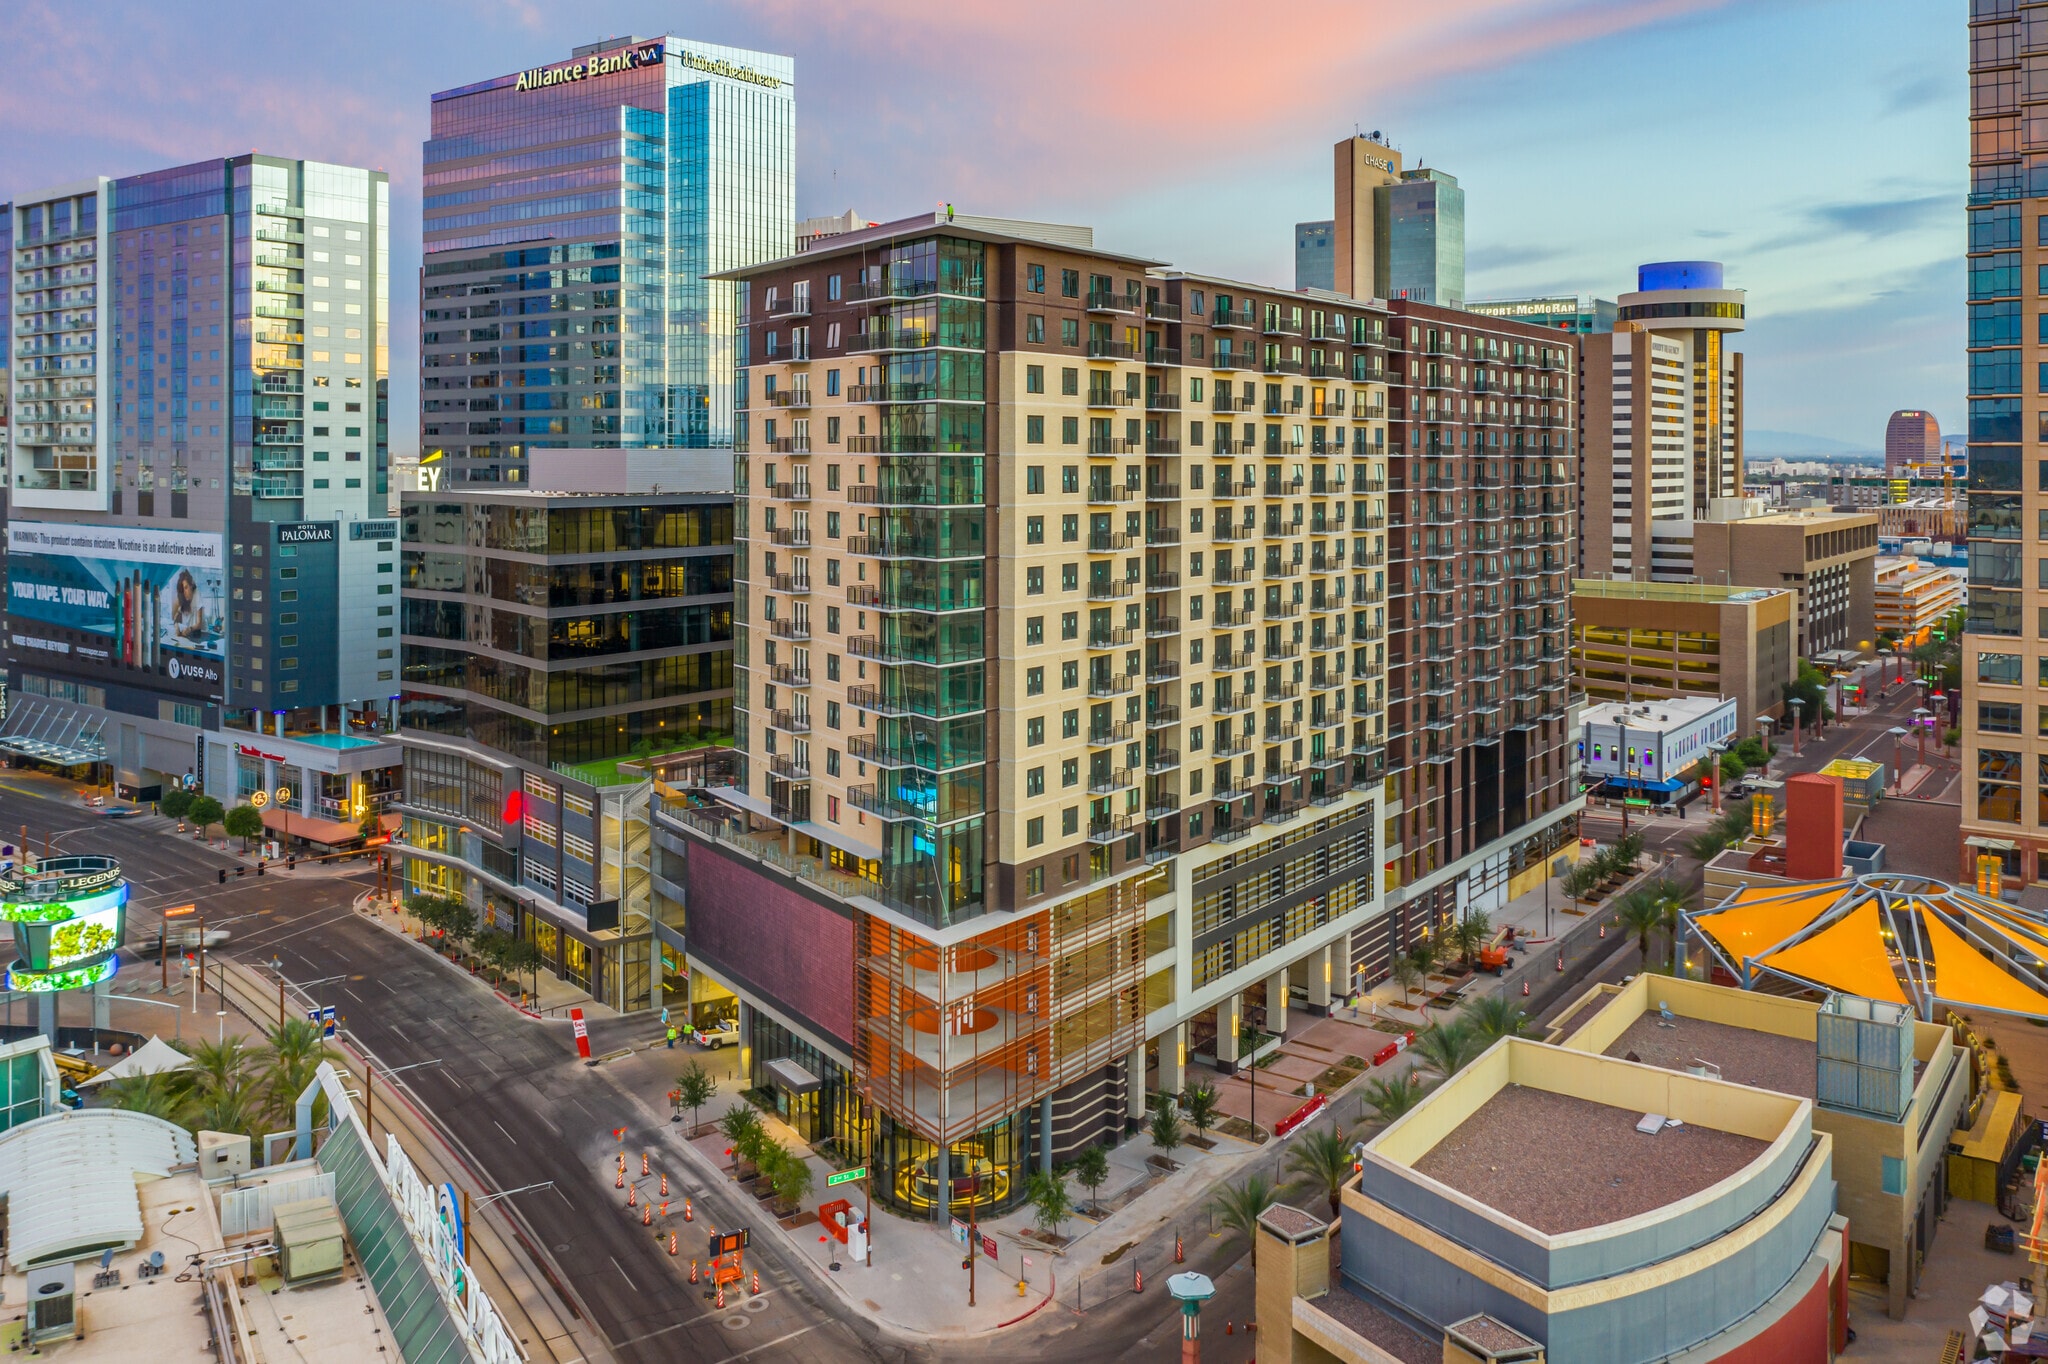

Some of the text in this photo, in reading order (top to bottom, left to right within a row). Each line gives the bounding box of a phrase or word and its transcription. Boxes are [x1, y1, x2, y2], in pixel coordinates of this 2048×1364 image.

[515, 65, 582, 91] Alliance
[588, 50, 633, 76] Bank
[681, 50, 781, 89] UnitedHealthcare
[1364, 153, 1387, 171] CHASE
[418, 466, 442, 492] EY
[13, 530, 216, 557] WARNING: This product contains nicotine. Nicotine is an addictive chemical.
[281, 530, 332, 541] PALOMAR
[12, 581, 110, 609] YOUR VAPE. YOUR WAY.
[205, 669, 218, 681] Alto
[70, 867, 121, 888] LEGENDS
